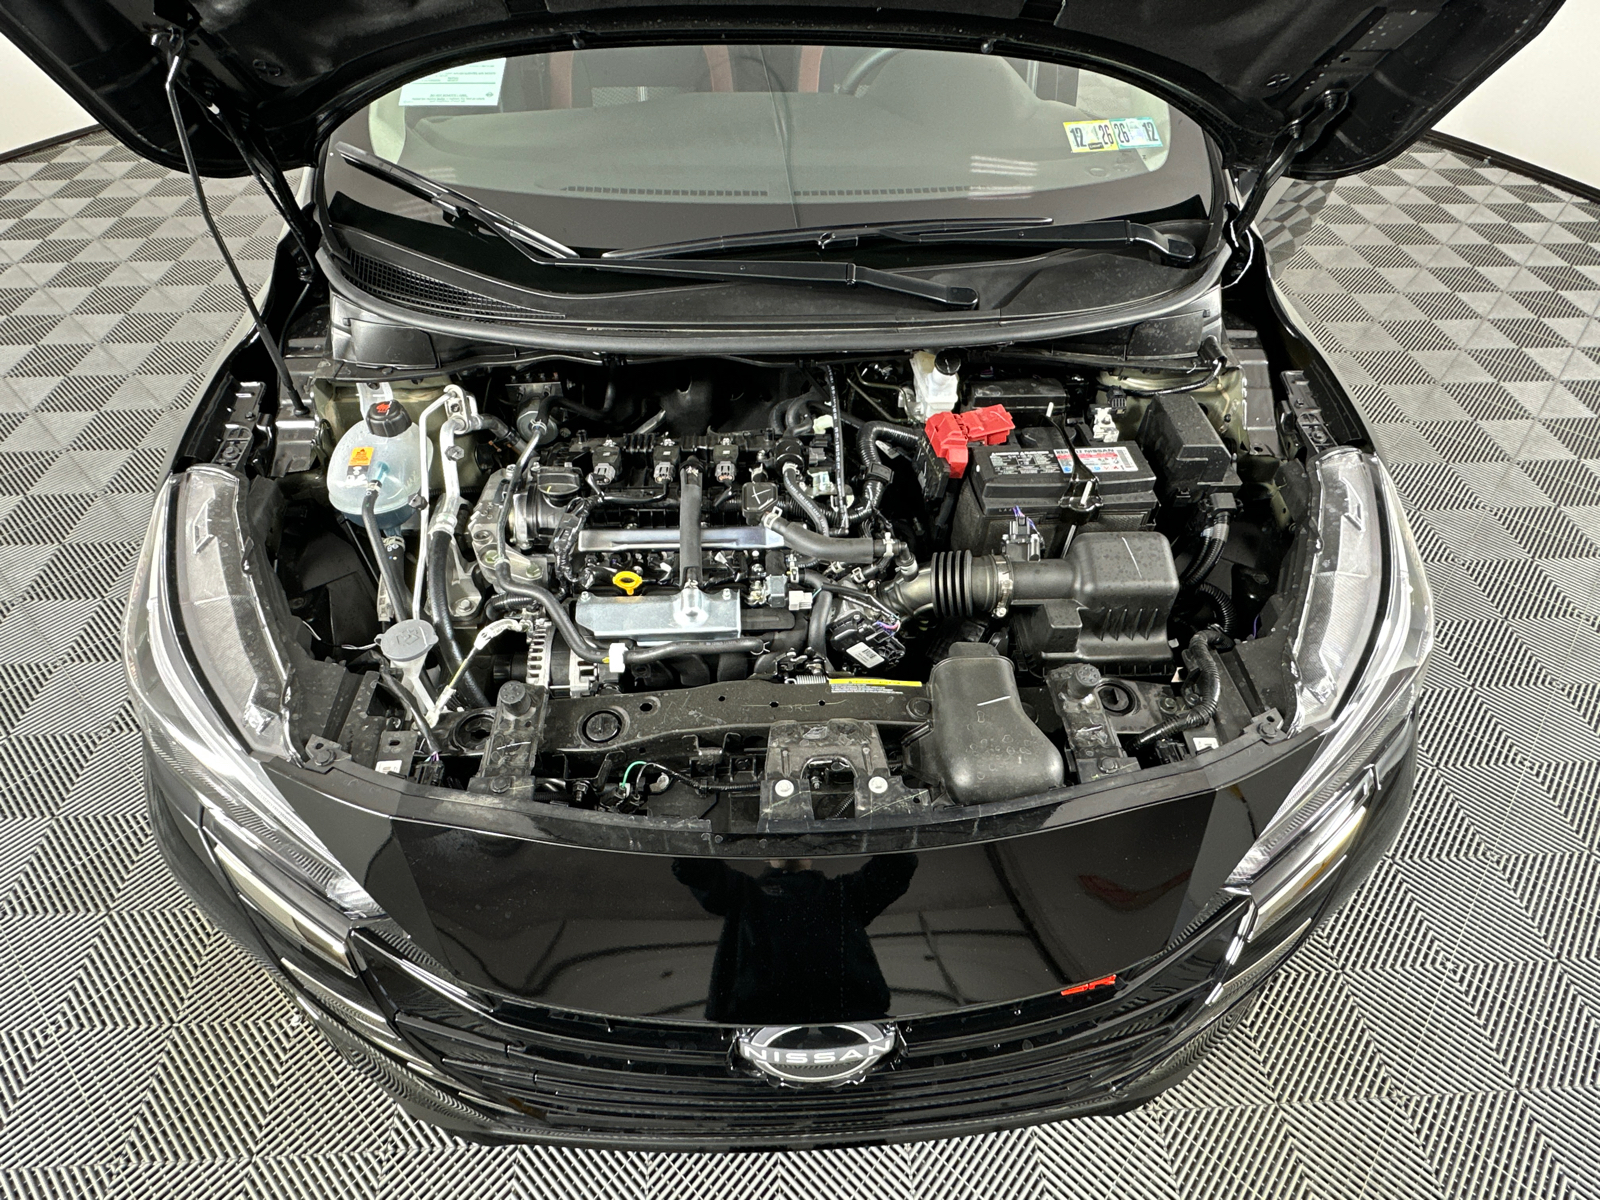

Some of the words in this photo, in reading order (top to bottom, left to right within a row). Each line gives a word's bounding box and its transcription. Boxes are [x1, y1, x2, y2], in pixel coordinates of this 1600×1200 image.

[1070, 127, 1087, 148] 12
[1098, 124, 1114, 145] 26
[1114, 123, 1130, 143] 26
[1142, 121, 1158, 142] 12
[744, 1039, 890, 1064] NISSAN
